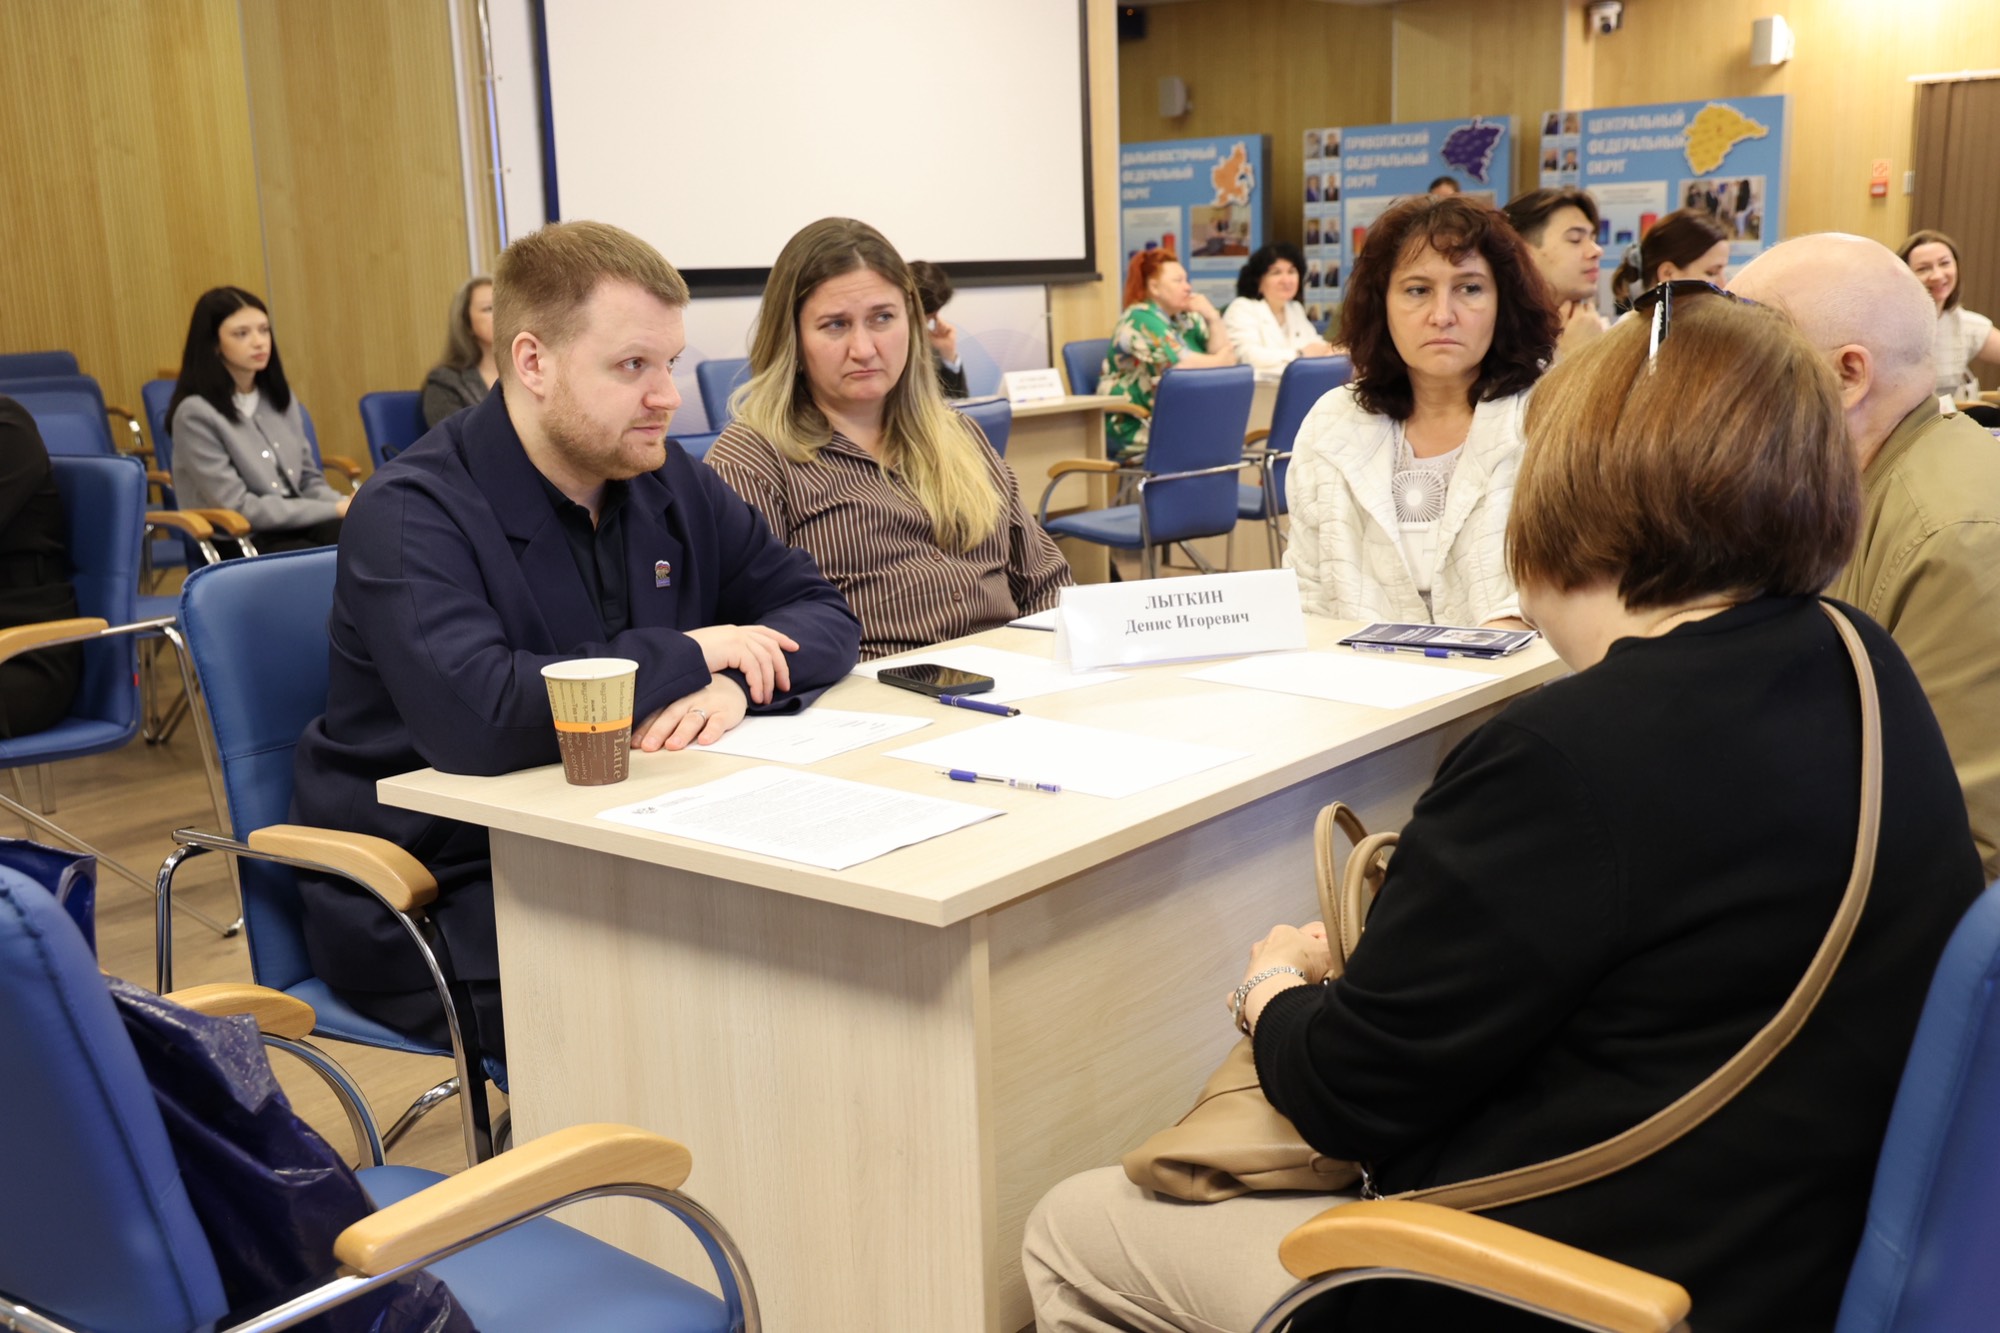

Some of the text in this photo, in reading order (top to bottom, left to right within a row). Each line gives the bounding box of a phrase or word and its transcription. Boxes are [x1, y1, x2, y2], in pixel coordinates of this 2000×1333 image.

[1588, 110, 1685, 133] ЦЕНТРАЛЬНЫЙ
[1145, 589, 1224, 610] ЛЫТКИН
[1125, 612, 1250, 635] Денис Игоревич
[613, 738, 624, 779] Latte
